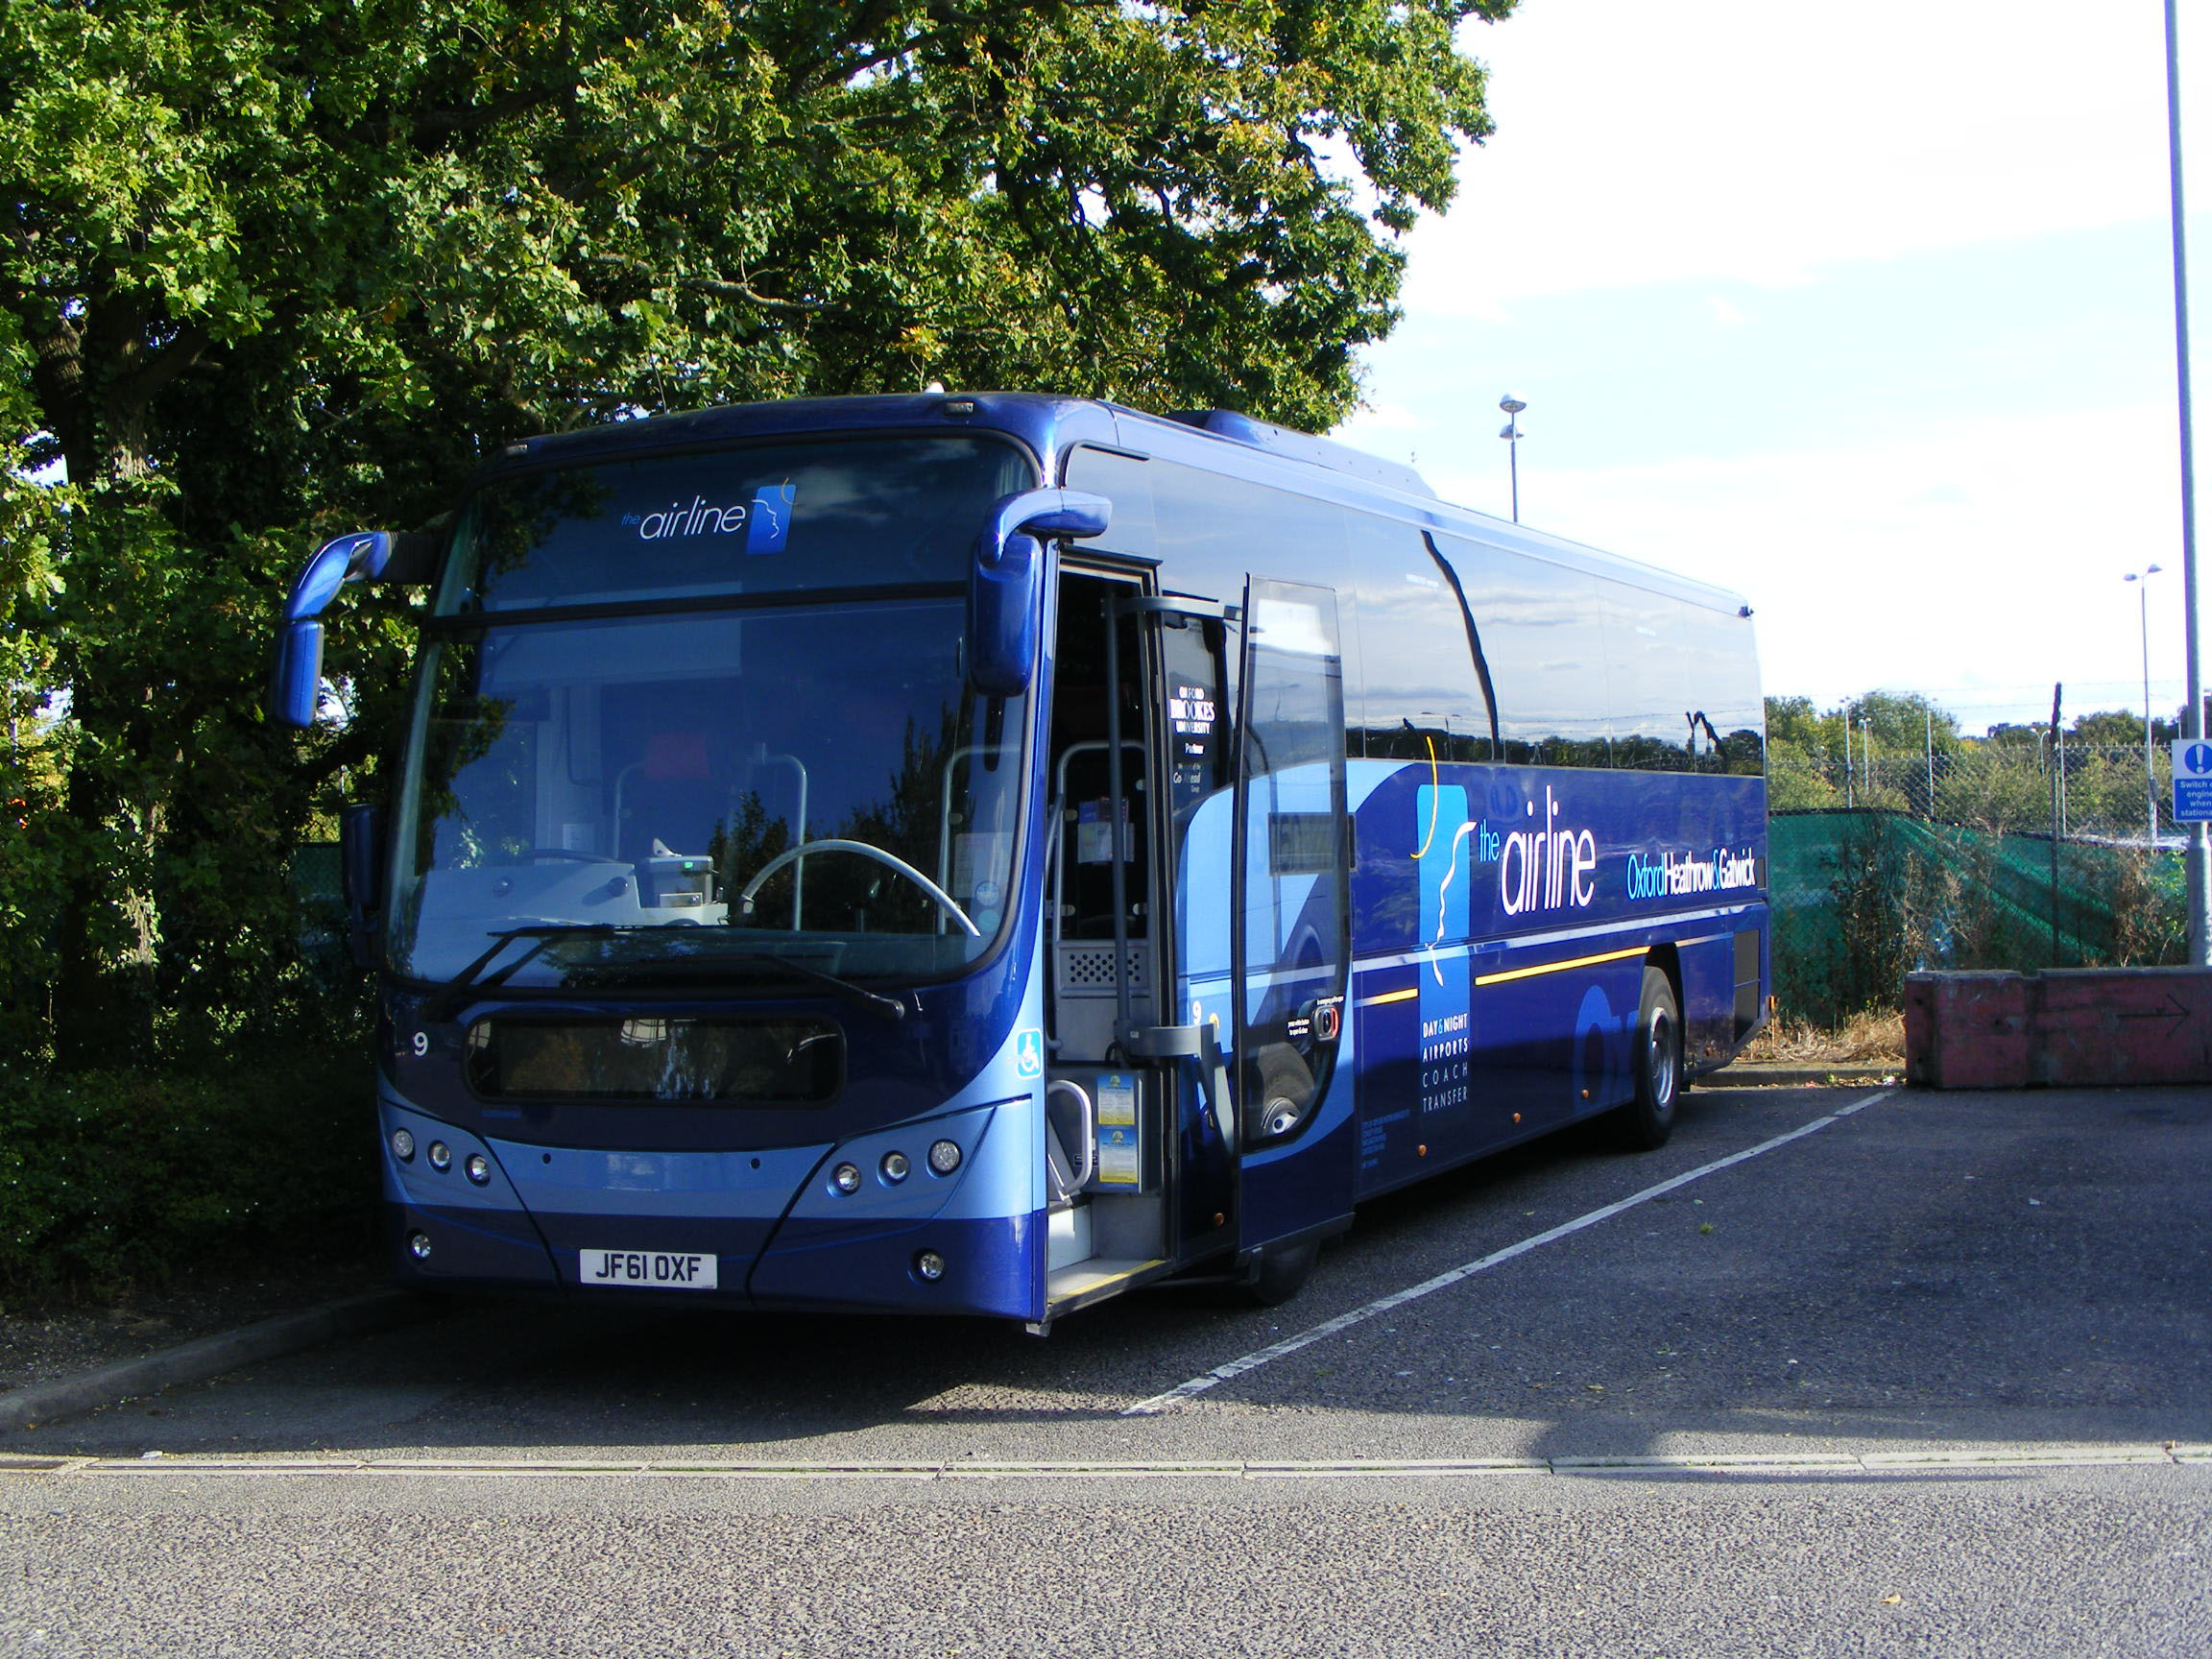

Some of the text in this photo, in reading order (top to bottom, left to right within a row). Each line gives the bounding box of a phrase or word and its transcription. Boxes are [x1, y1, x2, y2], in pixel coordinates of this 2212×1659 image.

[621, 494, 746, 540] the airline
[1169, 698, 1215, 721] BROOKES
[1175, 720, 1211, 734] UNIVERSITY
[2180, 780, 2208, 789] Switch
[2189, 799, 2212, 807] when
[1479, 784, 1597, 916] the airline
[1192, 999, 1202, 1025] 9
[414, 1031, 428, 1056] 9
[1422, 1037, 1468, 1063] AIRPORTS
[1422, 1061, 1468, 1088] COACH
[1422, 1086, 1468, 1114] TRANSFER
[595, 1253, 702, 1282] JF61 OXF
